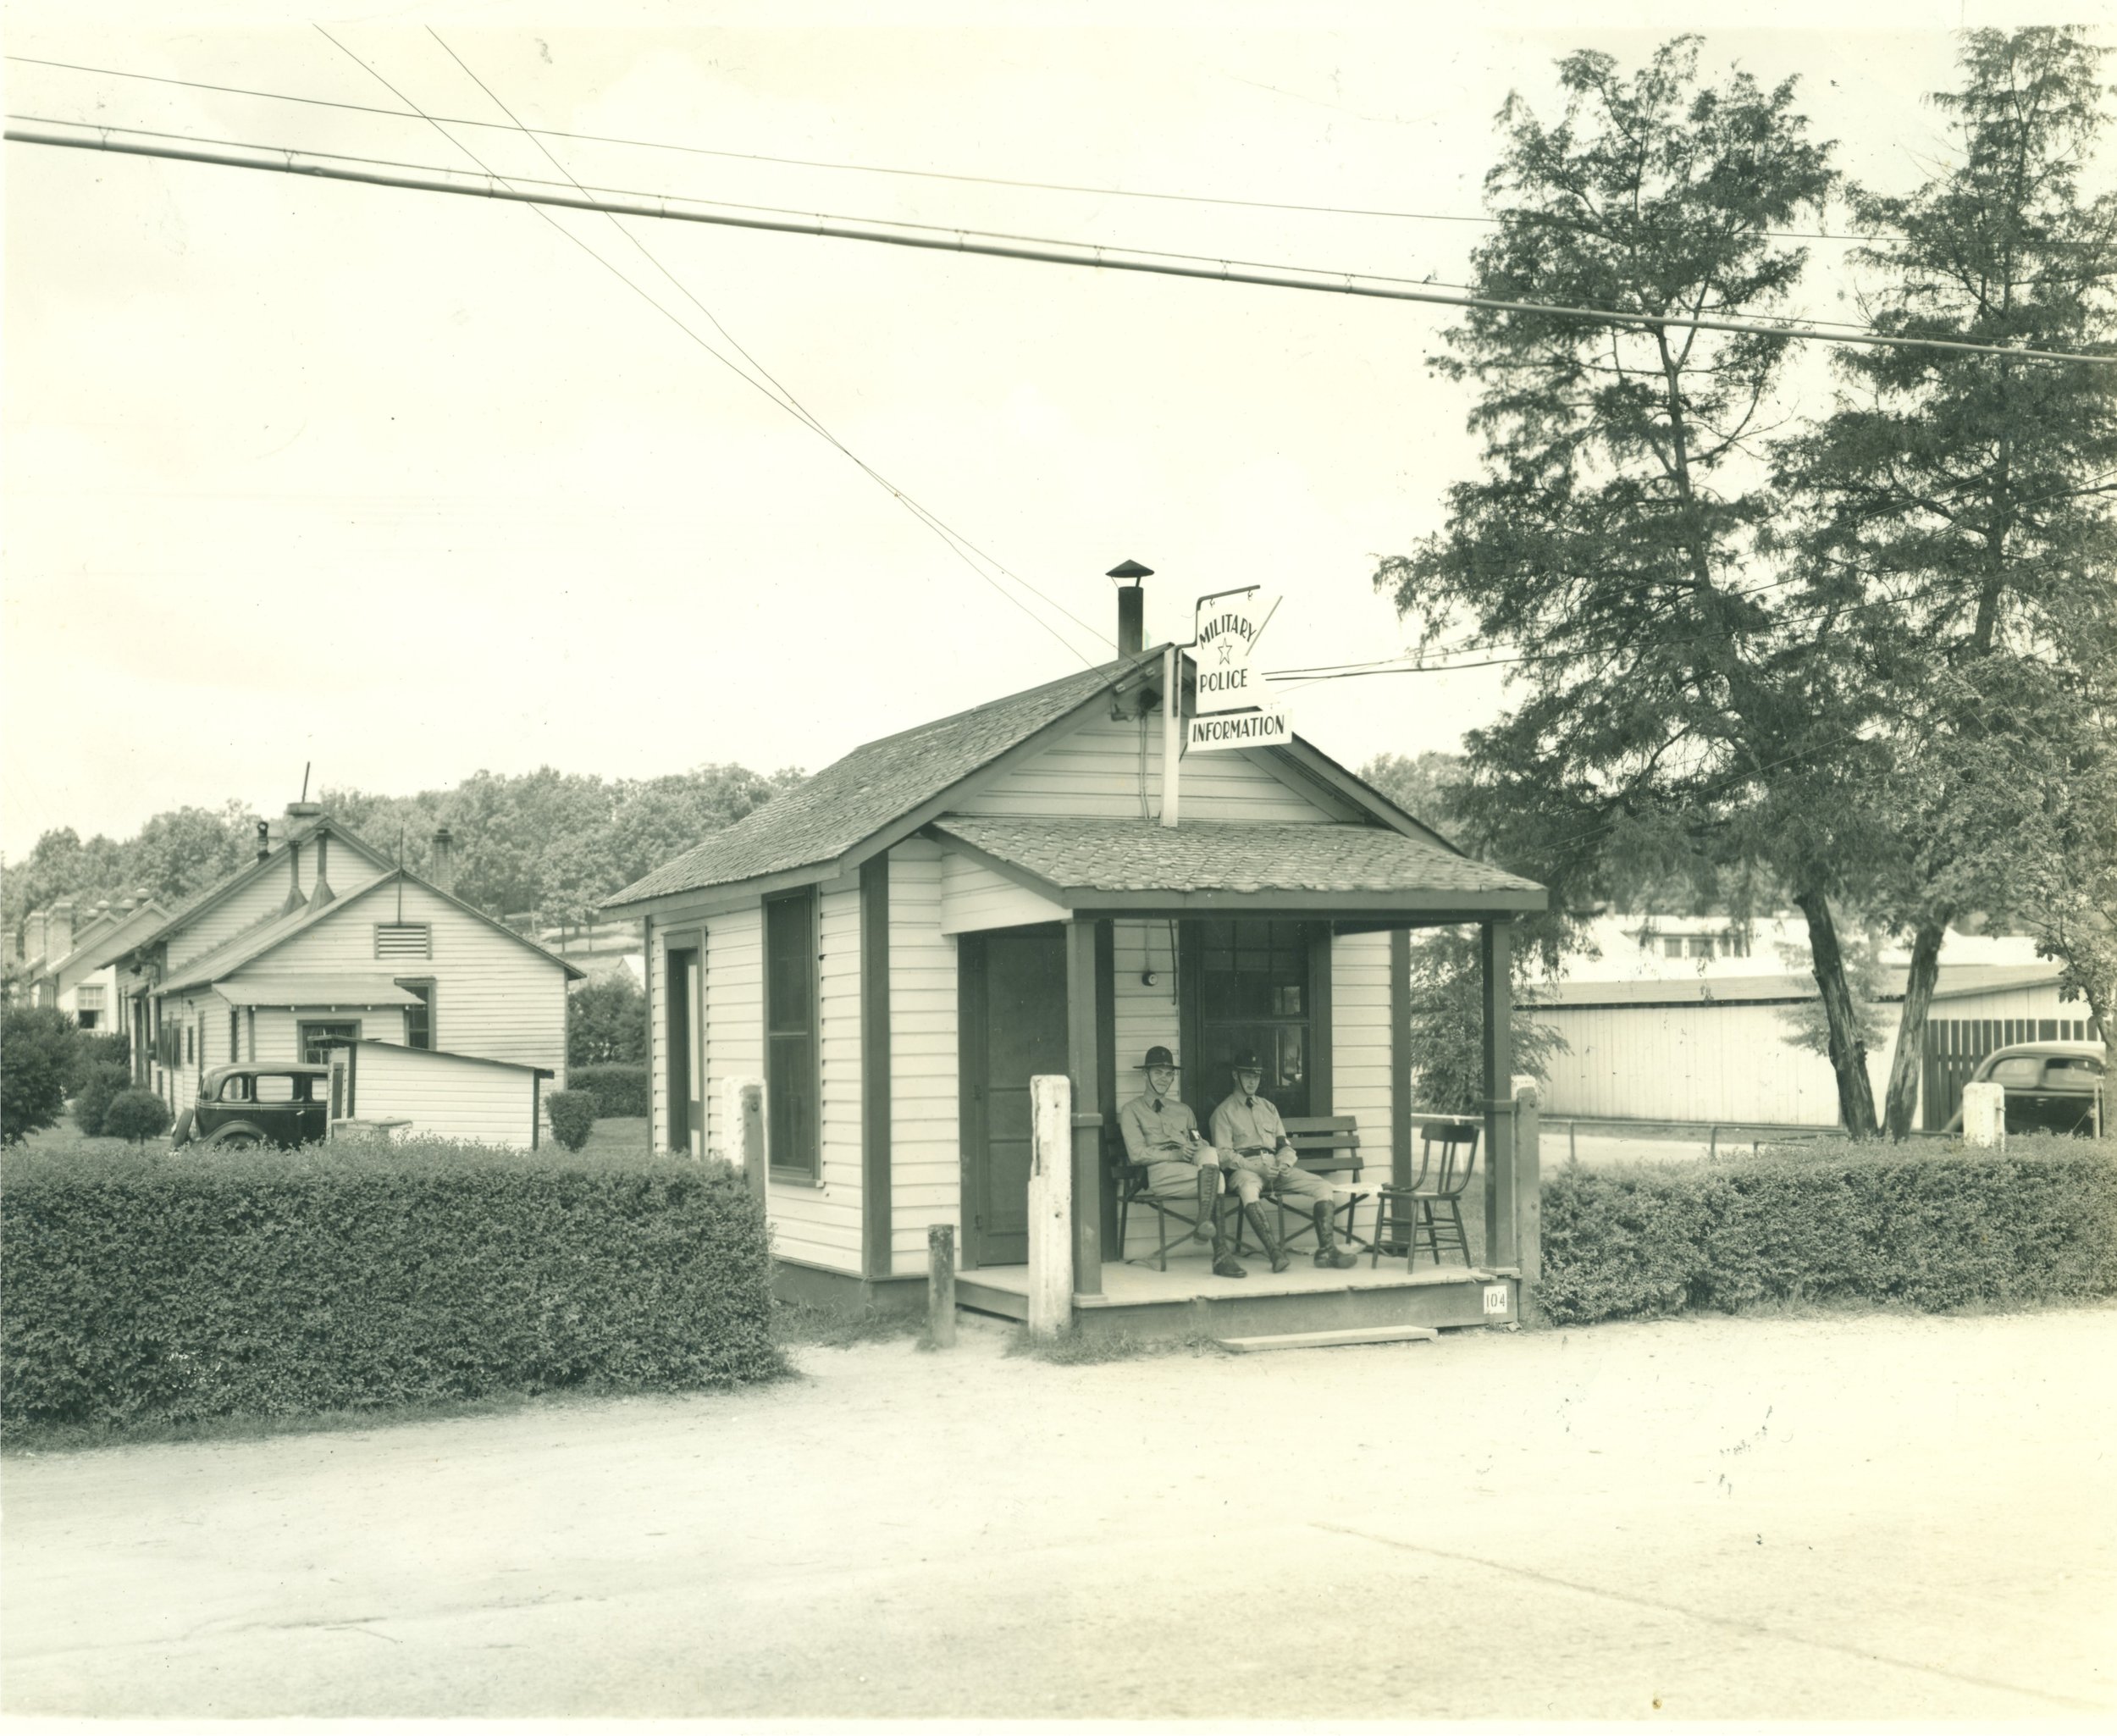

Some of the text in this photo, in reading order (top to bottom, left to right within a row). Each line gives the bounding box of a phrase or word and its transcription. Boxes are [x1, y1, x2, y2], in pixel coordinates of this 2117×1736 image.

[1199, 614, 1257, 650] MILITARY
[1199, 668, 1248, 694] POLICE
[1192, 715, 1285, 743] INFORMATION
[1486, 1293, 1506, 1308] 104
